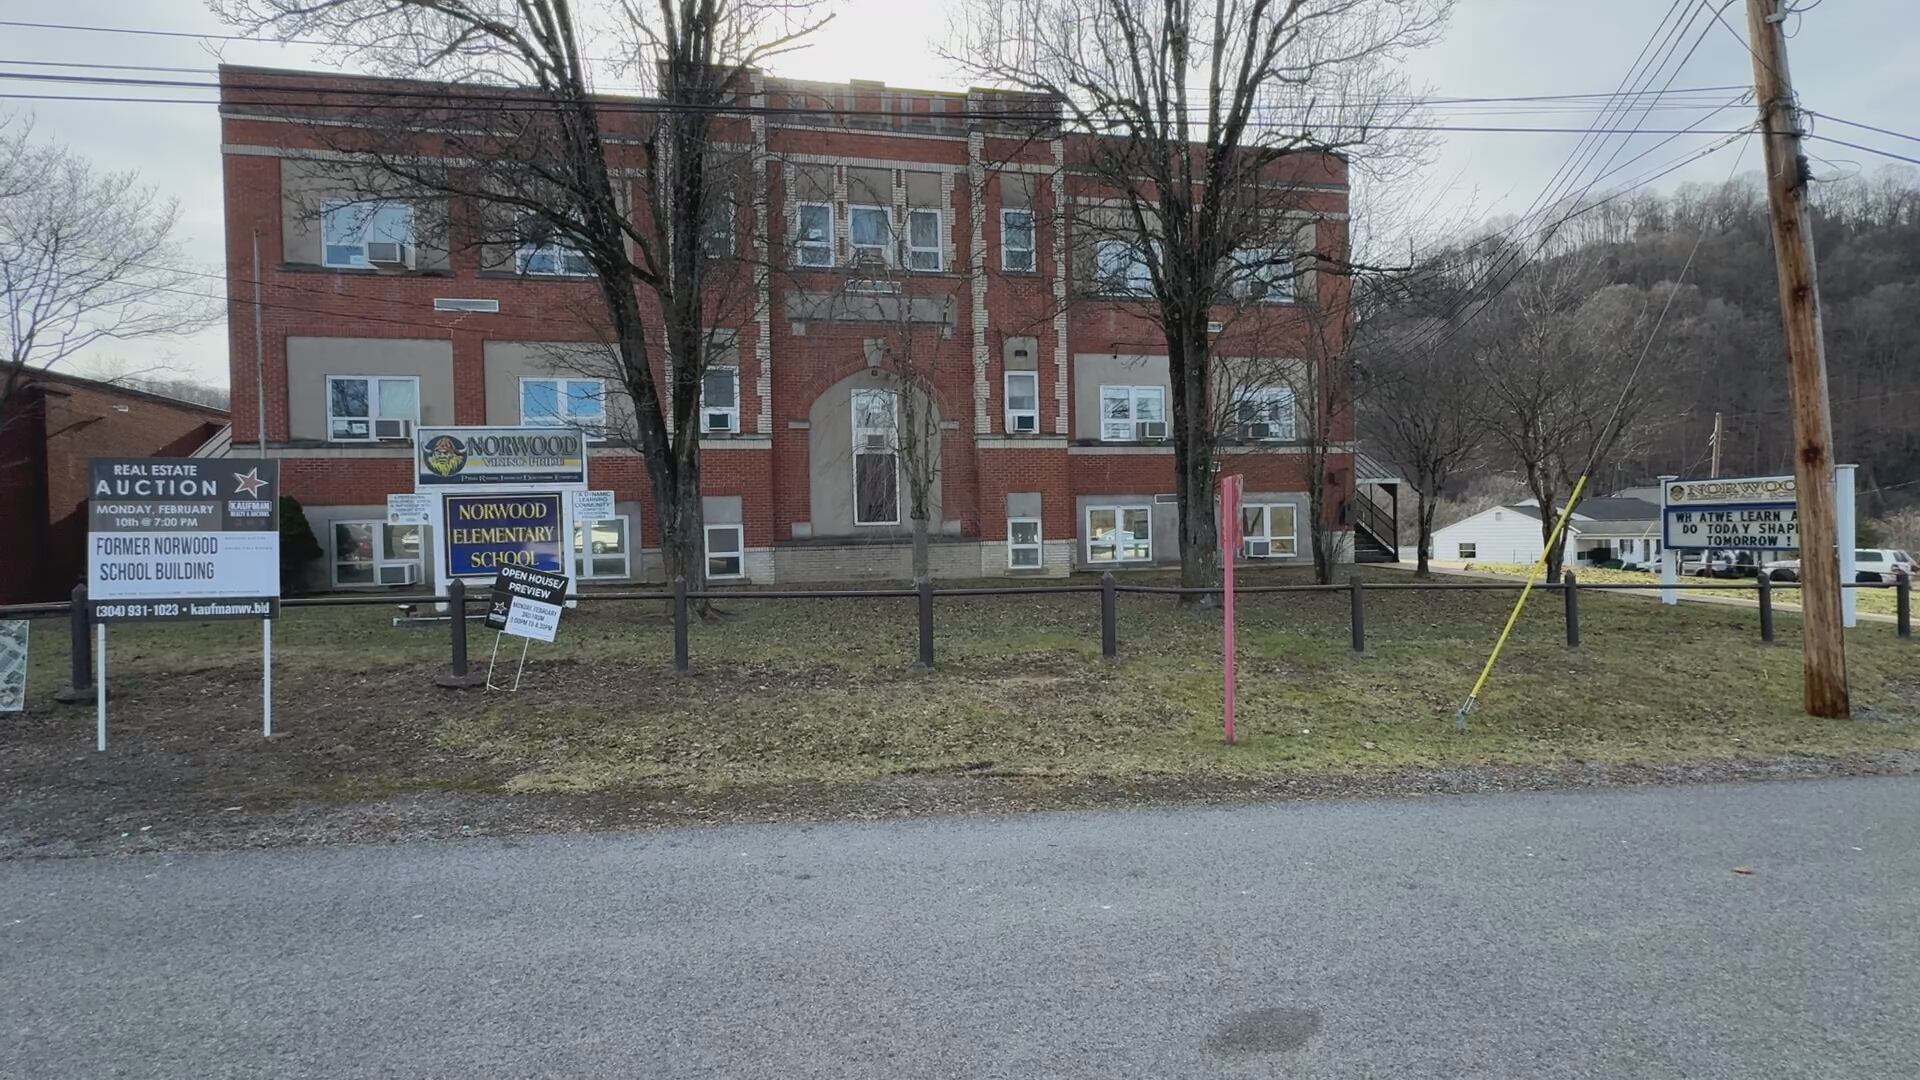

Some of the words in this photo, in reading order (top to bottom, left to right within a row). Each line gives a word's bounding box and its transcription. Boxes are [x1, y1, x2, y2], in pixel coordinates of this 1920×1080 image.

[468, 435, 577, 456] NORWOOD
[114, 465, 147, 476] REAL
[152, 464, 197, 476] ESTATE
[95, 479, 217, 496] AUCTION
[1687, 480, 1797, 496] NORWOO
[96, 505, 155, 515] MONDAY,
[158, 505, 214, 514] FEBRUARY
[231, 502, 270, 510] KAUFMAN
[459, 502, 547, 520] NORWOOD
[115, 518, 139, 527] 10th
[141, 518, 150, 527] @
[153, 518, 178, 527] 7:00
[180, 518, 198, 527] PM
[1740, 511, 1780, 522] LEARN
[453, 526, 554, 544] ELEMENTARY
[1683, 524, 1697, 534] DO
[1708, 523, 1750, 534] TODAY
[96, 537, 151, 556] FORMER
[154, 536, 218, 555] NORWOOD
[1706, 535, 1778, 547] TOMORROW
[471, 550, 540, 568] SCHOOL
[100, 562, 152, 581] SCHOOL
[155, 561, 215, 580] BUILDING
[502, 567, 528, 581] OPEN
[528, 574, 565, 589] HOUSE/
[508, 582, 551, 599] PREVIEW
[96, 605, 126, 617] (304)
[127, 604, 179, 617] 931-1023
[191, 602, 270, 616] kaufmanwv.bid
